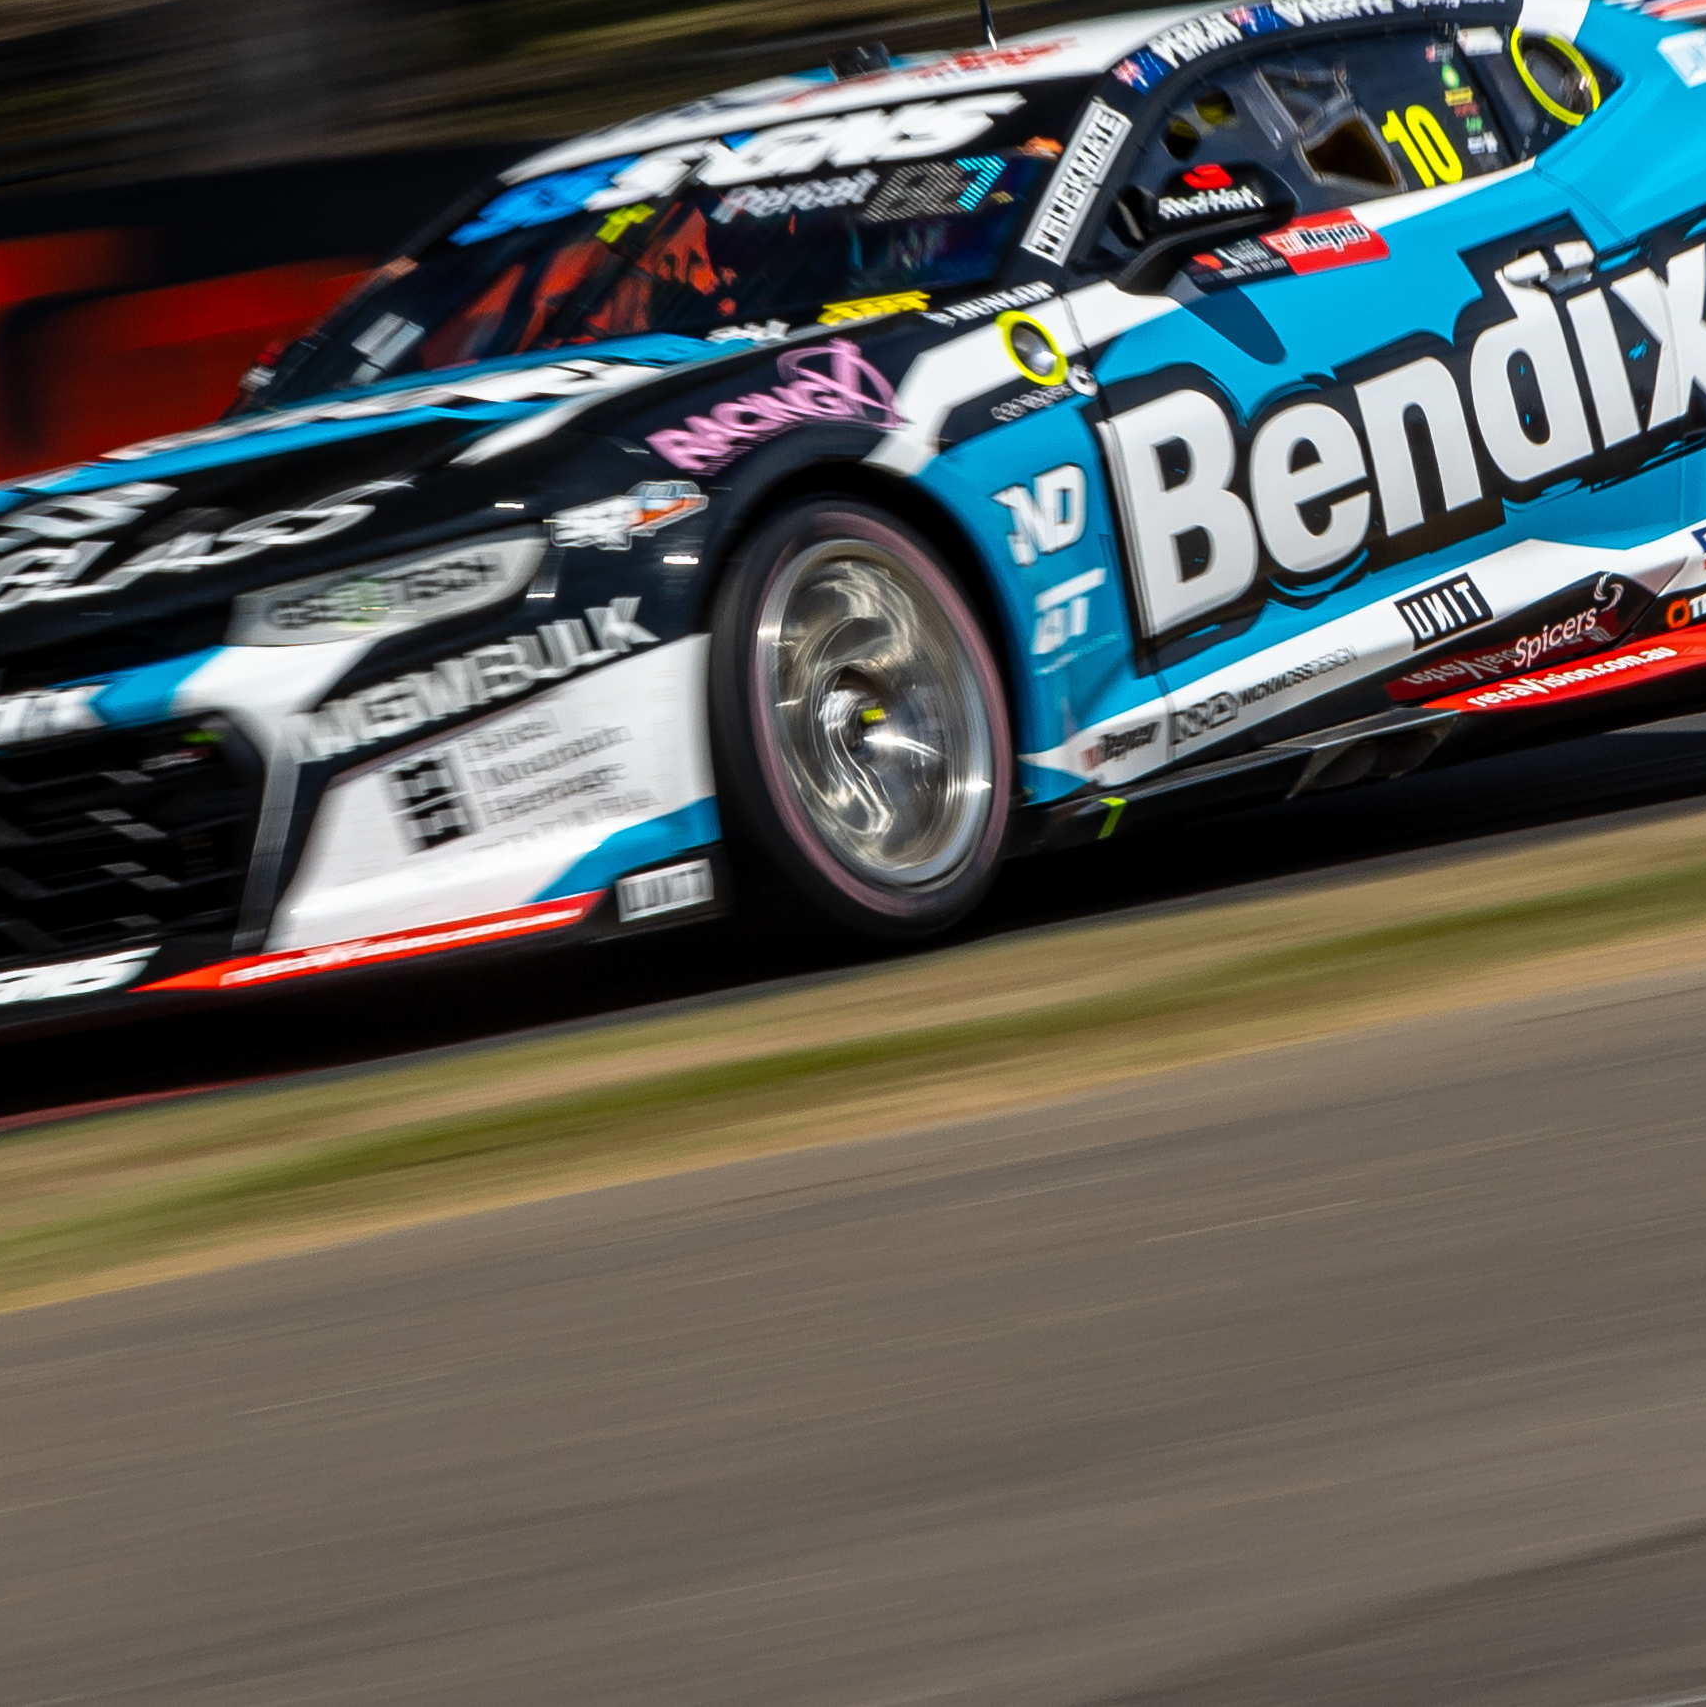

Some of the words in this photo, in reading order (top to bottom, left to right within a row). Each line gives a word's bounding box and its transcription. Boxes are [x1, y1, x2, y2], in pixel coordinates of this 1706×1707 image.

[1031, 109, 1122, 256] TRUCKMATE
[1382, 105, 1463, 188] 10
[1512, 606, 1597, 668] Spicers
[1466, 645, 1679, 709] retraVision.com.au
